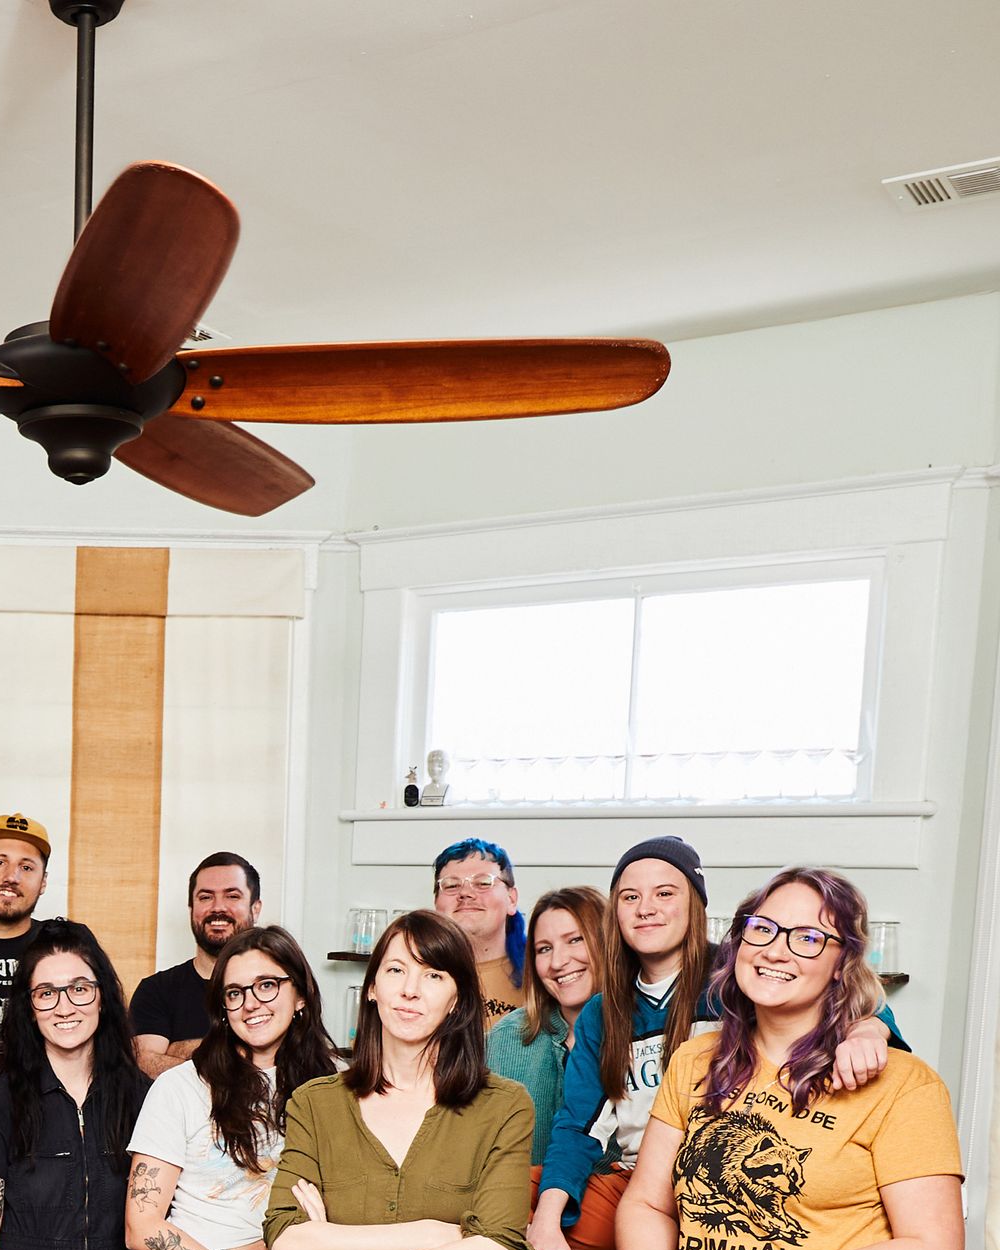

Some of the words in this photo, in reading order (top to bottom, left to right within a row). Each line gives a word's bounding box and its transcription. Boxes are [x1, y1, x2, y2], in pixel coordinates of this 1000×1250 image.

[636, 1044, 664, 1059] JACKS
[743, 1092, 789, 1113] BORN
[811, 1111, 837, 1130] BE
